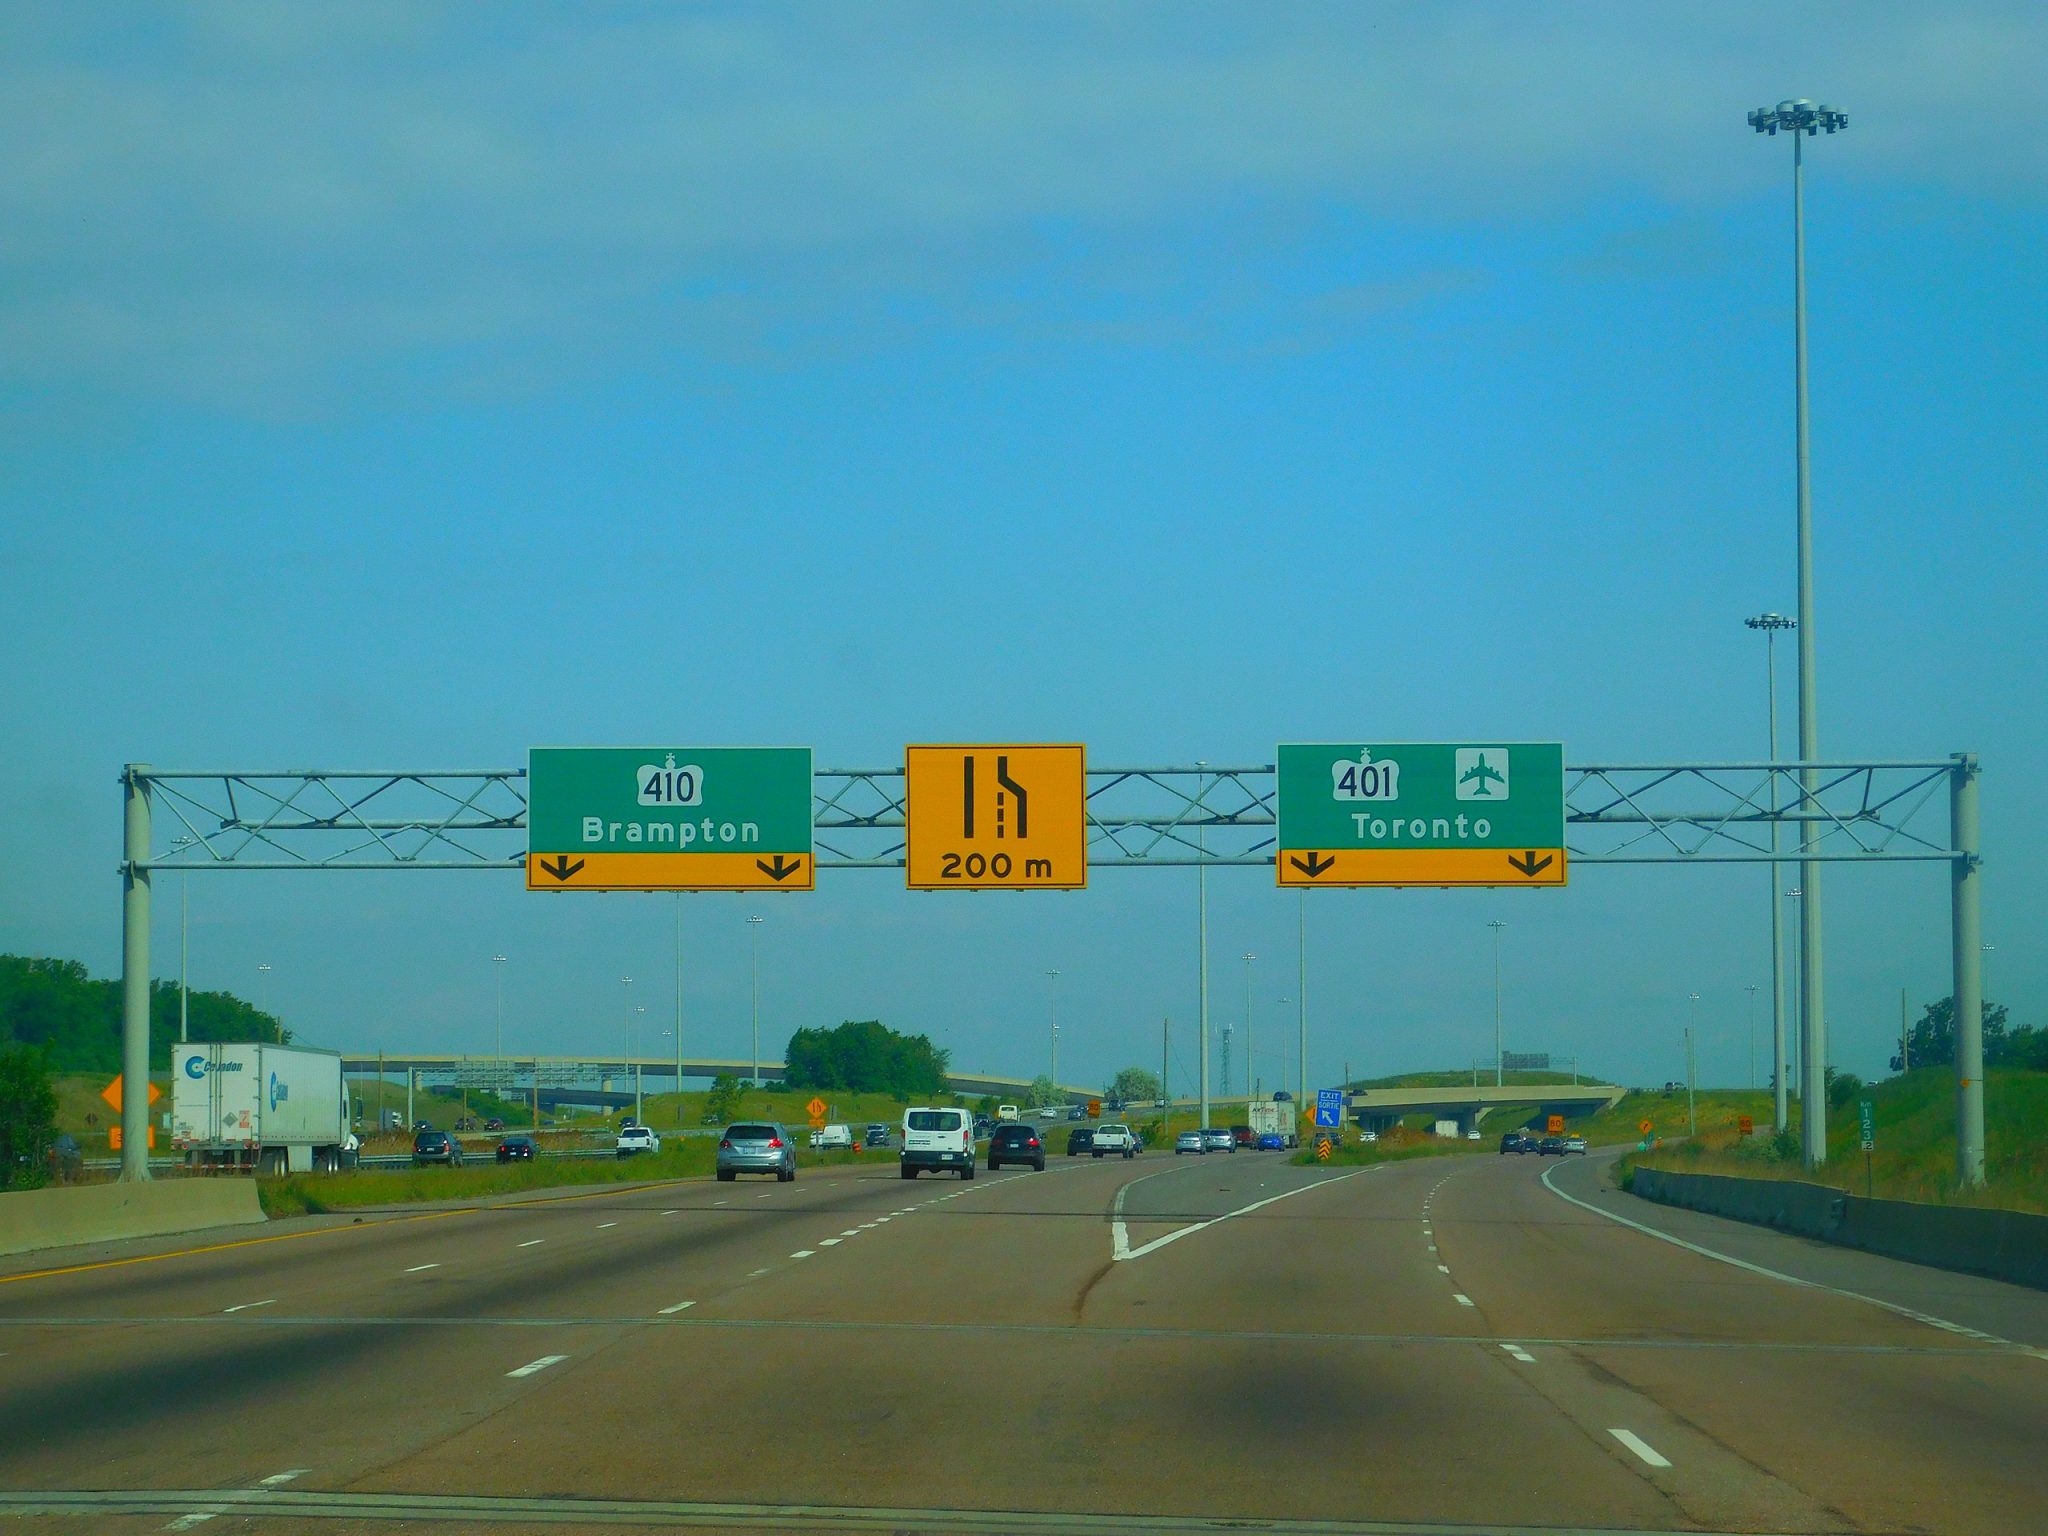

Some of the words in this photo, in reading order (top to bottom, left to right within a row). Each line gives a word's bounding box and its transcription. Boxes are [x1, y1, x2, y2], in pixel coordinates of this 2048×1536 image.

[642, 771, 695, 803] 410
[1337, 765, 1391, 798] 401
[581, 816, 760, 850] Brampton
[1351, 812, 1492, 840] Toronto
[940, 852, 1013, 879] 200
[1025, 858, 1052, 878] m
[1318, 1101, 1341, 1110] SORTIE
[1320, 1091, 1340, 1100] EXIT
